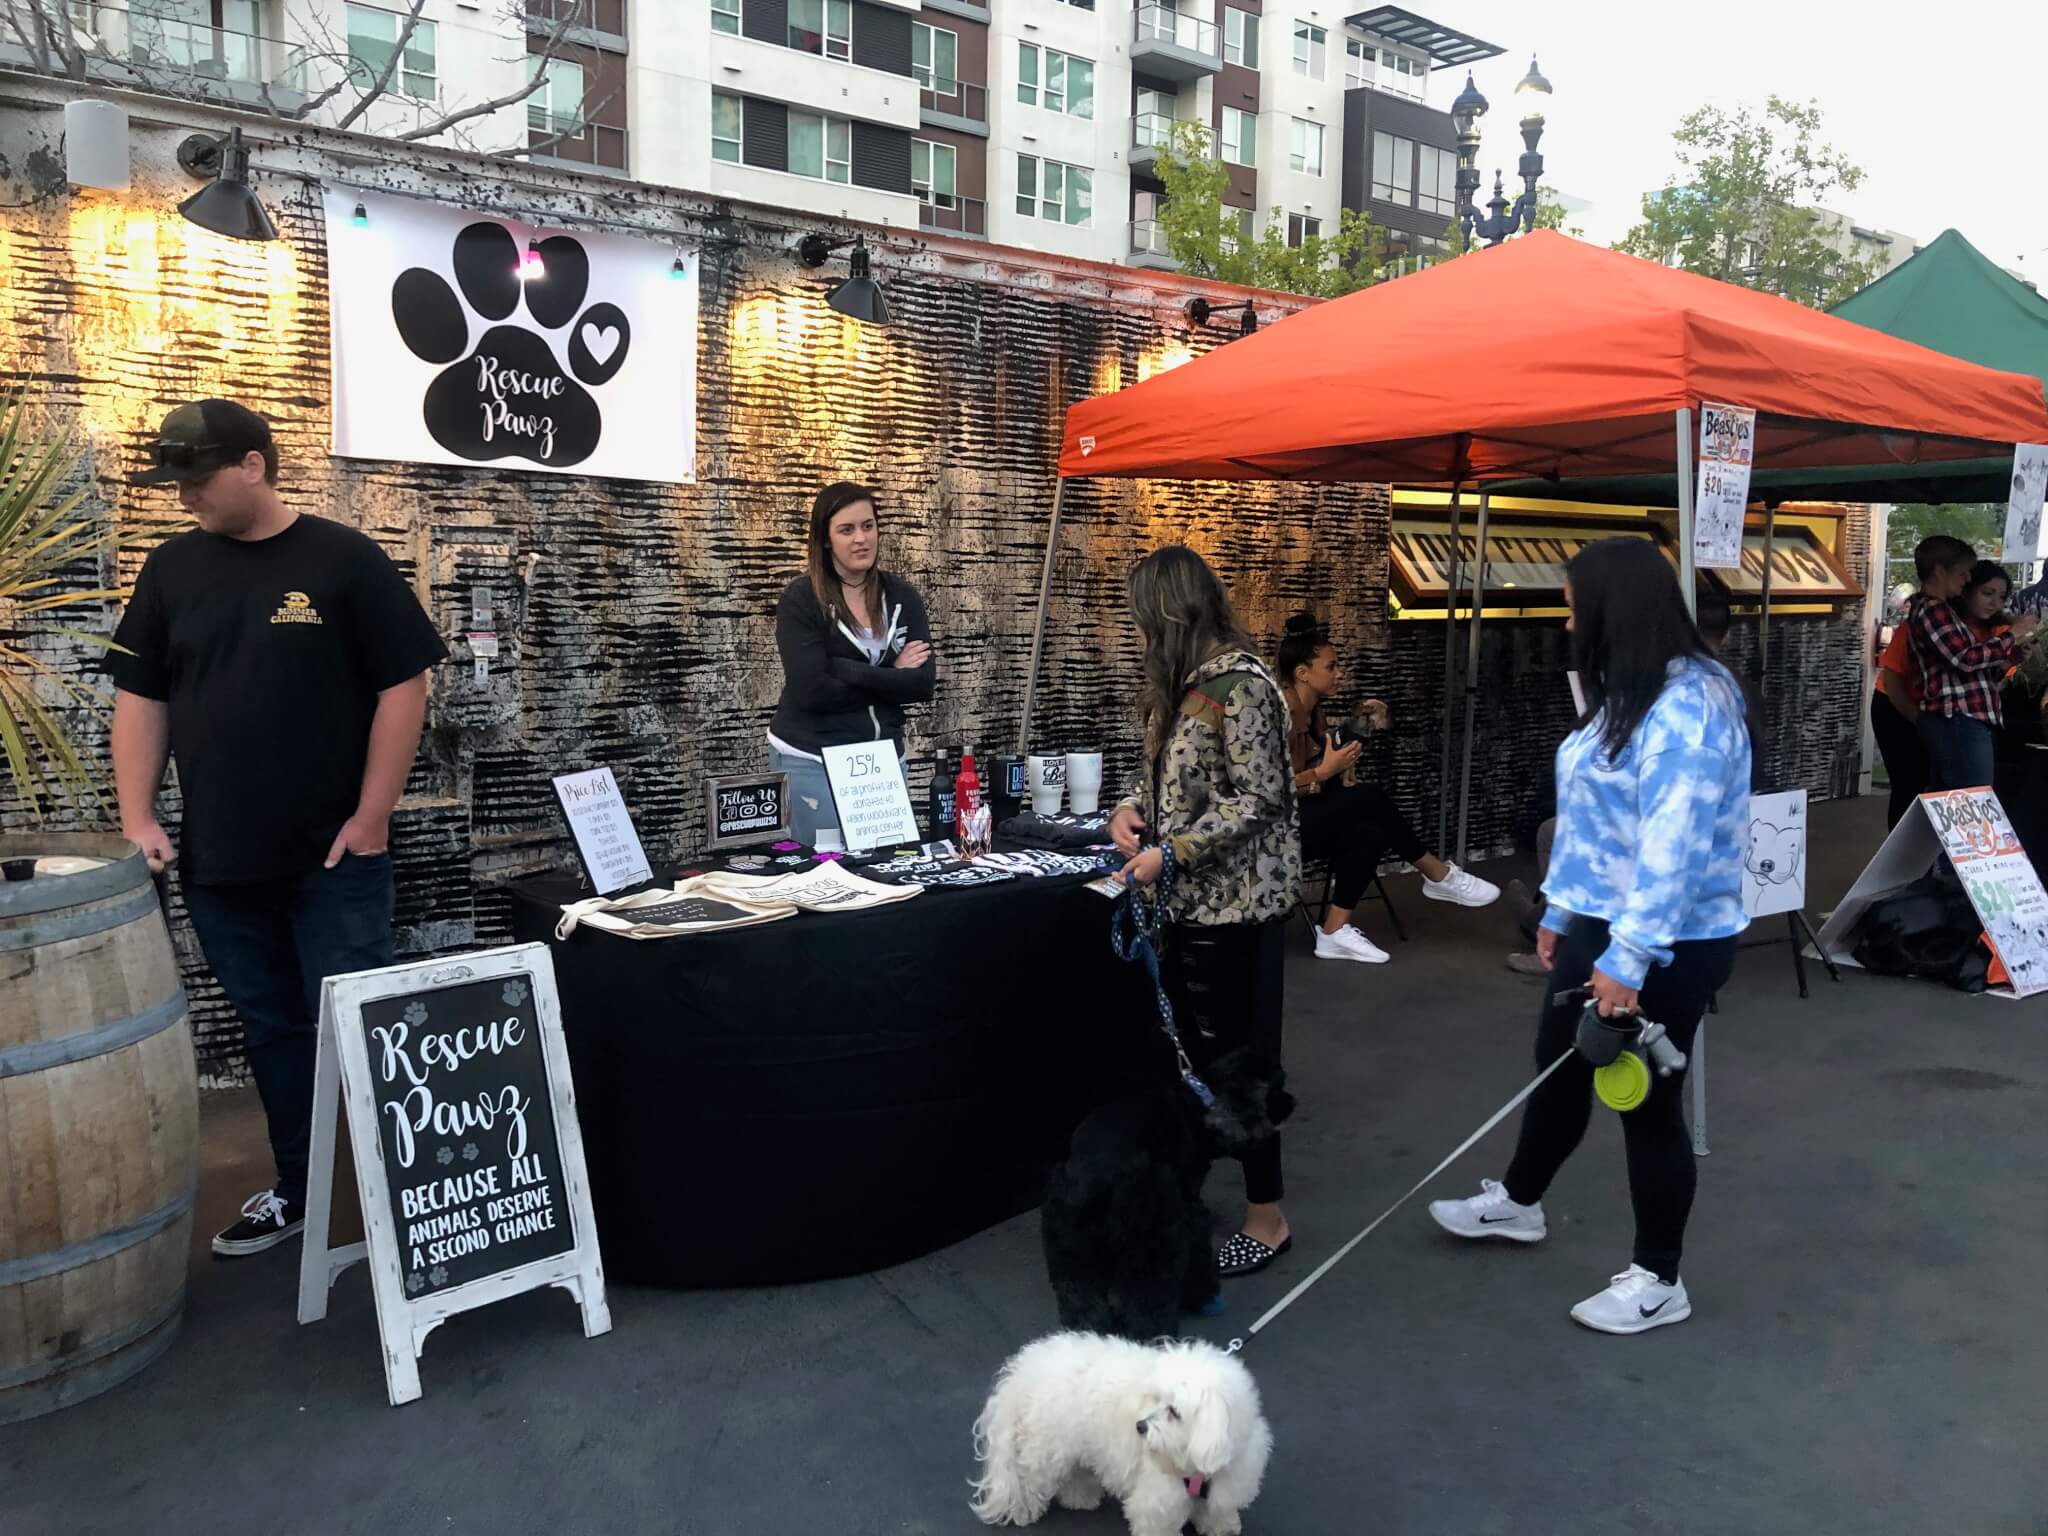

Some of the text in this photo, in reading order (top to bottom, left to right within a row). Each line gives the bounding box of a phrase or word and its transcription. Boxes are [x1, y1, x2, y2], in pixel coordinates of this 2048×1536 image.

[475, 355, 565, 400] Rescue
[480, 400, 558, 459] Pawz
[1705, 411, 1750, 440] Beasties
[1704, 472, 1721, 496] $20
[563, 774, 611, 801] Price List
[846, 753, 880, 777] 25%
[719, 788, 777, 808] Follow Us
[1931, 797, 2002, 832] Beasties
[372, 1016, 526, 1086] Rescue
[385, 1085, 531, 1169] Pawz
[401, 1152, 548, 1219] BECAUSE ALL
[408, 1184, 552, 1247] ANIMALS DESERVE
[412, 1208, 556, 1270] A SECOND CHANCE
